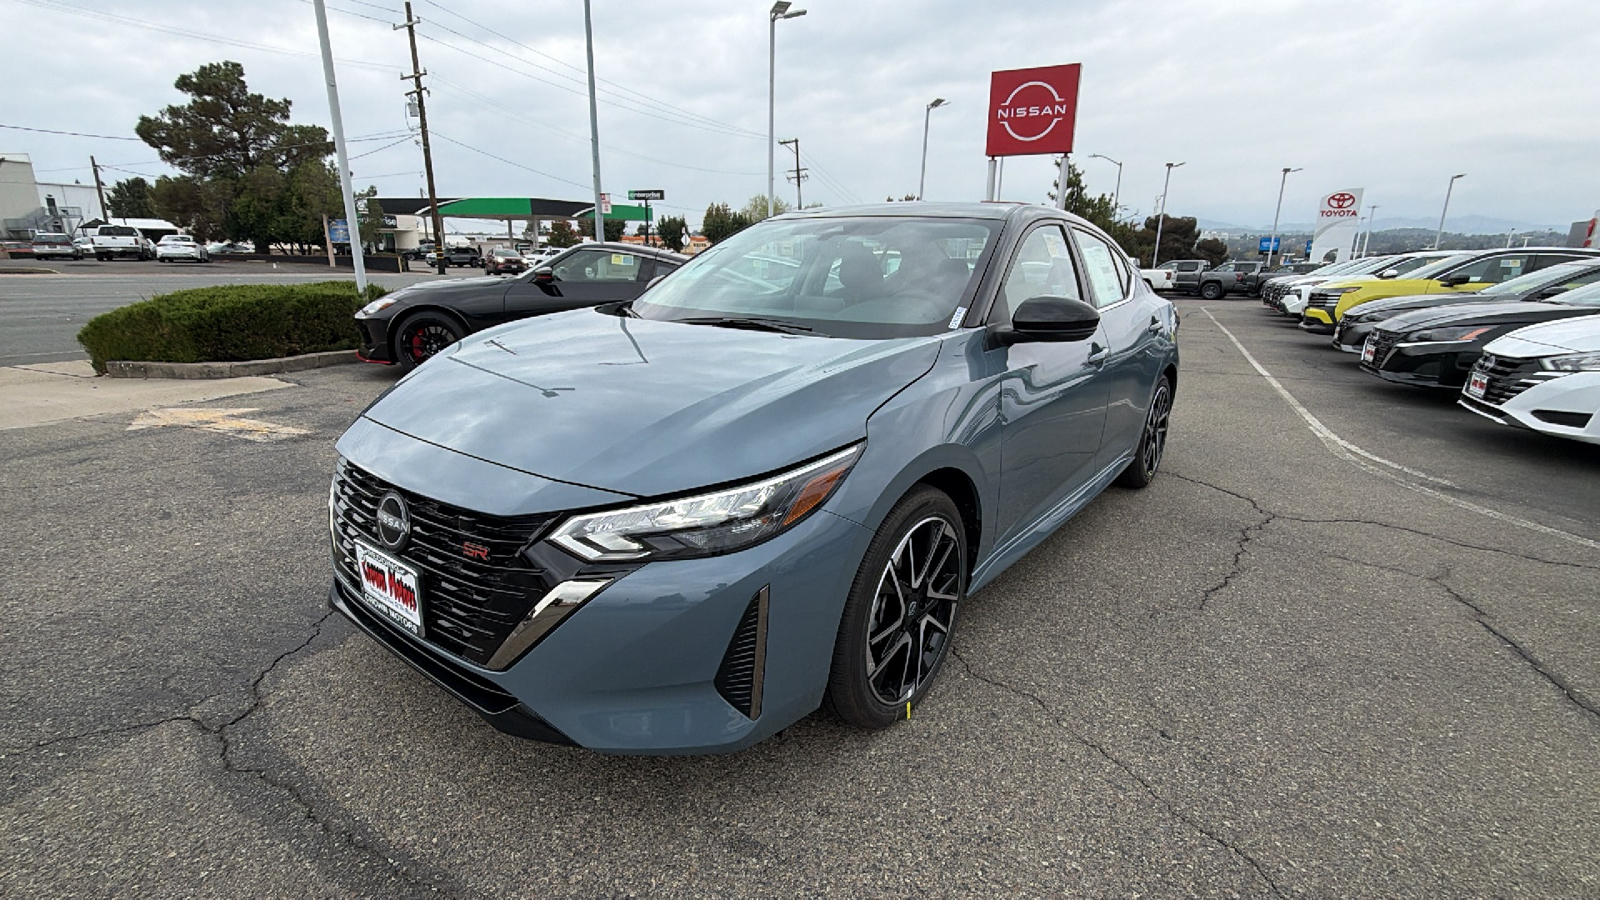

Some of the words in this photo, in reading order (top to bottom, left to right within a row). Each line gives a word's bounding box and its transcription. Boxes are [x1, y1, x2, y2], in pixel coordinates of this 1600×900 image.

[997, 104, 1067, 119] NISSAN
[629, 191, 661, 199] enterprise
[463, 541, 488, 560] SR
[362, 560, 387, 593] Crown
[387, 566, 417, 612] Motors
[364, 592, 389, 614] CROWN
[389, 608, 418, 634] MOTORS
